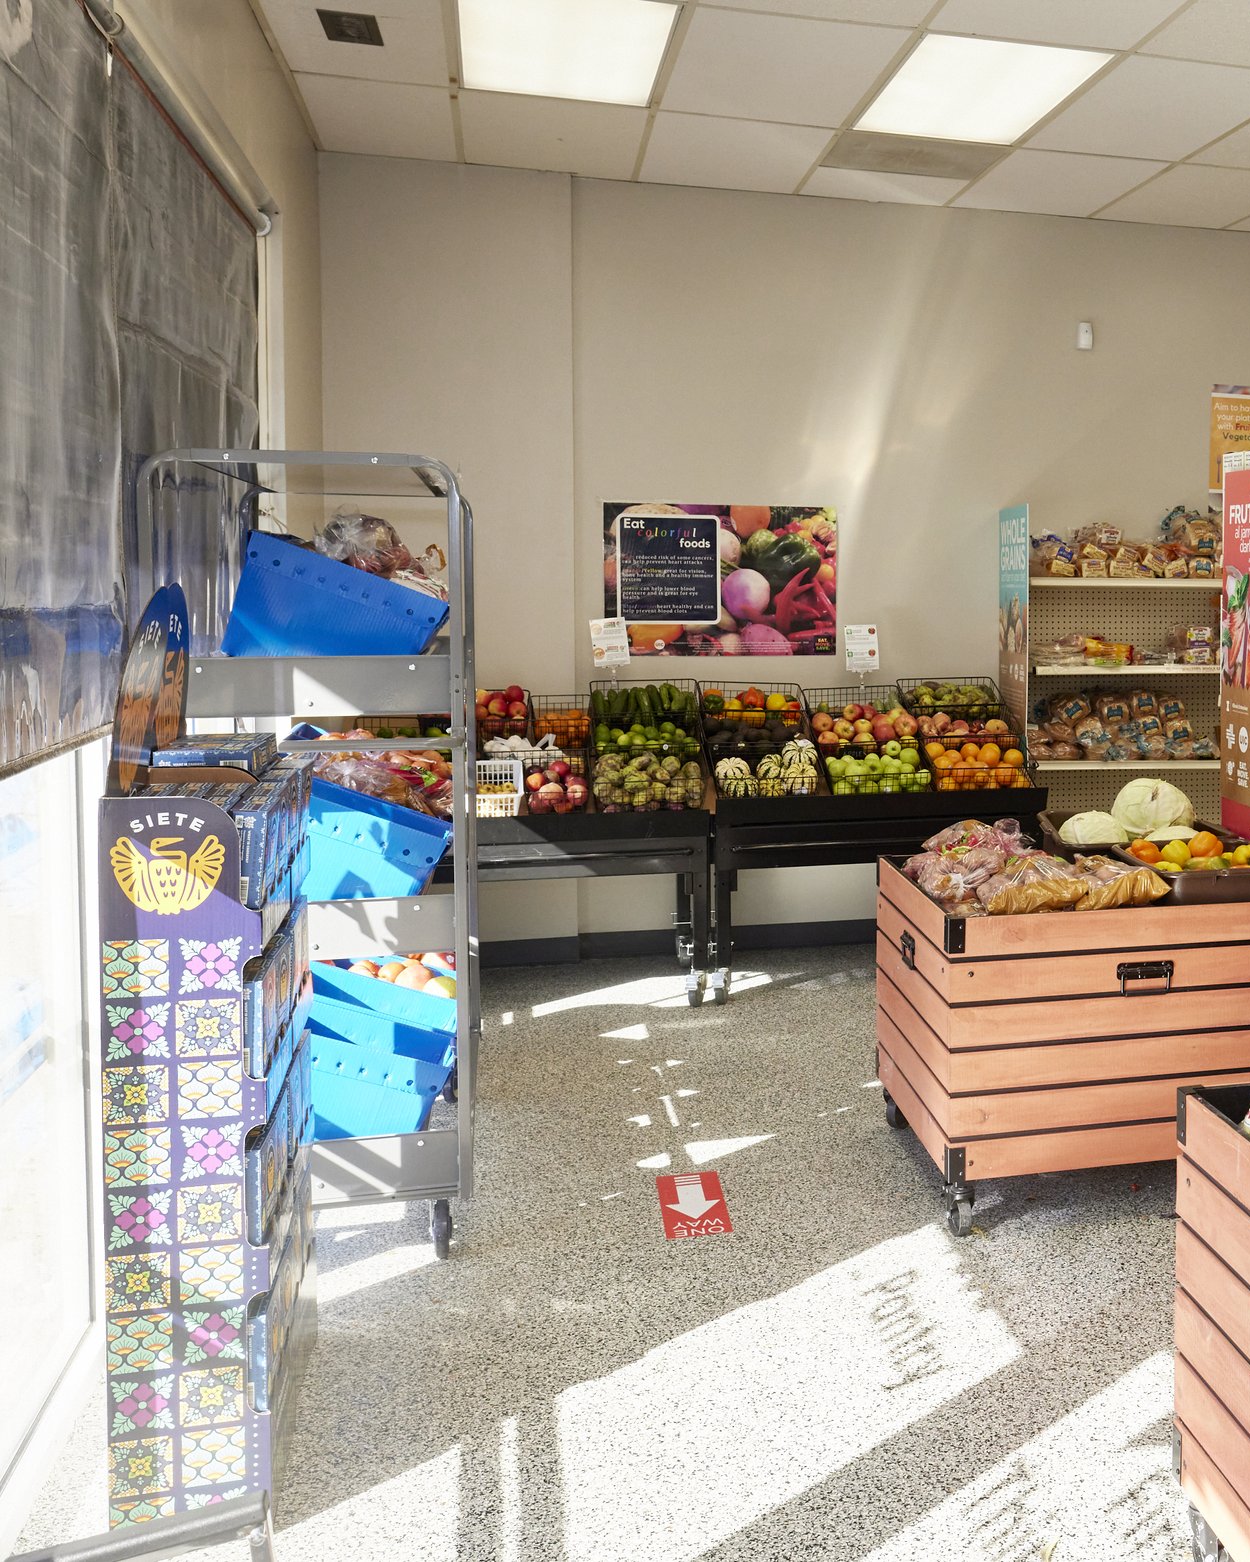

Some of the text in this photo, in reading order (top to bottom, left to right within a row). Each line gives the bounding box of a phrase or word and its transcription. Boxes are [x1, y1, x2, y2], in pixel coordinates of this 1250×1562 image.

[1214, 402, 1229, 410] Aim
[1217, 422, 1233, 430] with
[623, 518, 645, 529] Eat
[637, 527, 697, 539] colorful
[1001, 517, 1025, 545] WHOLE
[680, 538, 711, 548] foods
[1001, 547, 1025, 571] GRAINS
[169, 614, 183, 641] ETE
[129, 812, 205, 834] SIETE
[672, 1217, 725, 1229] WAY
[675, 1225, 725, 1238] ONE
